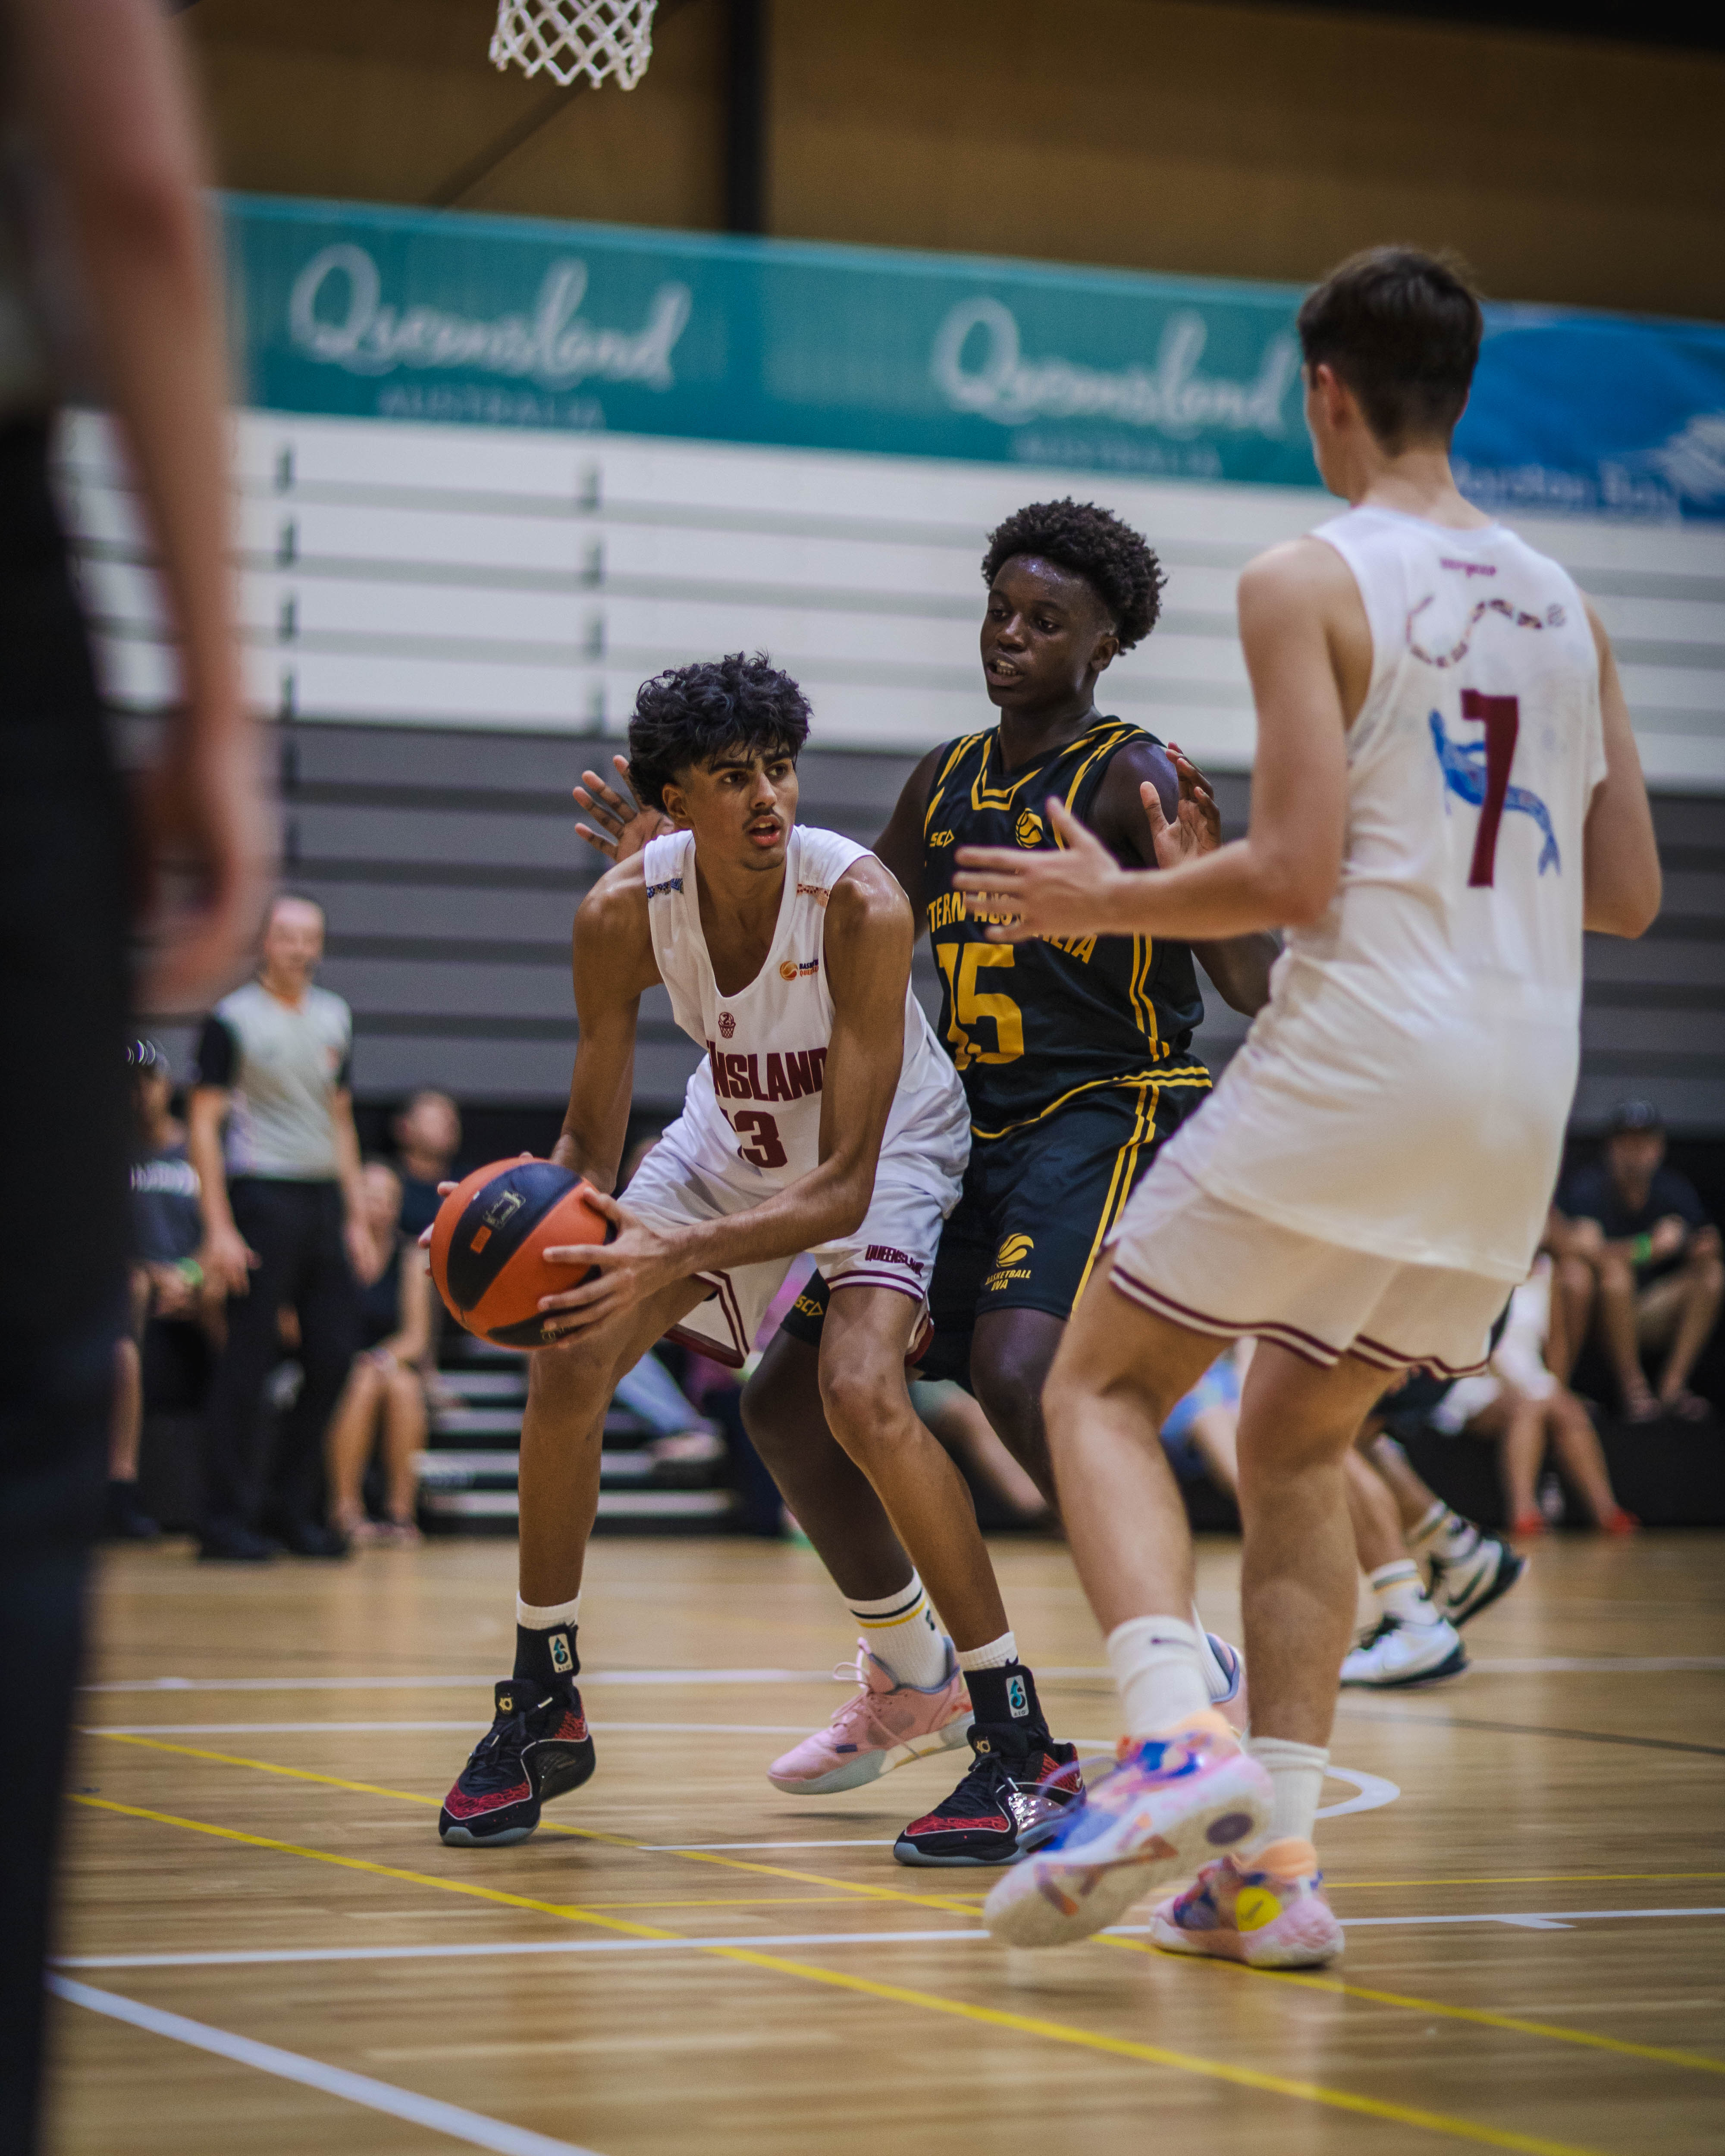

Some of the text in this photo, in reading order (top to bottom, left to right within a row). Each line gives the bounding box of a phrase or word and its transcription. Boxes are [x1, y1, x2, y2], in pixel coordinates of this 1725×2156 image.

[290, 242, 691, 392] Queensland
[929, 296, 1296, 440] Queensland
[1461, 689, 1519, 888] 7
[927, 892, 966, 933] TERN
[936, 942, 1024, 1071] 15
[706, 1039, 828, 1102] NSLAND
[719, 1106, 788, 1169] 3
[985, 1269, 1032, 1285] BASKETBALL
